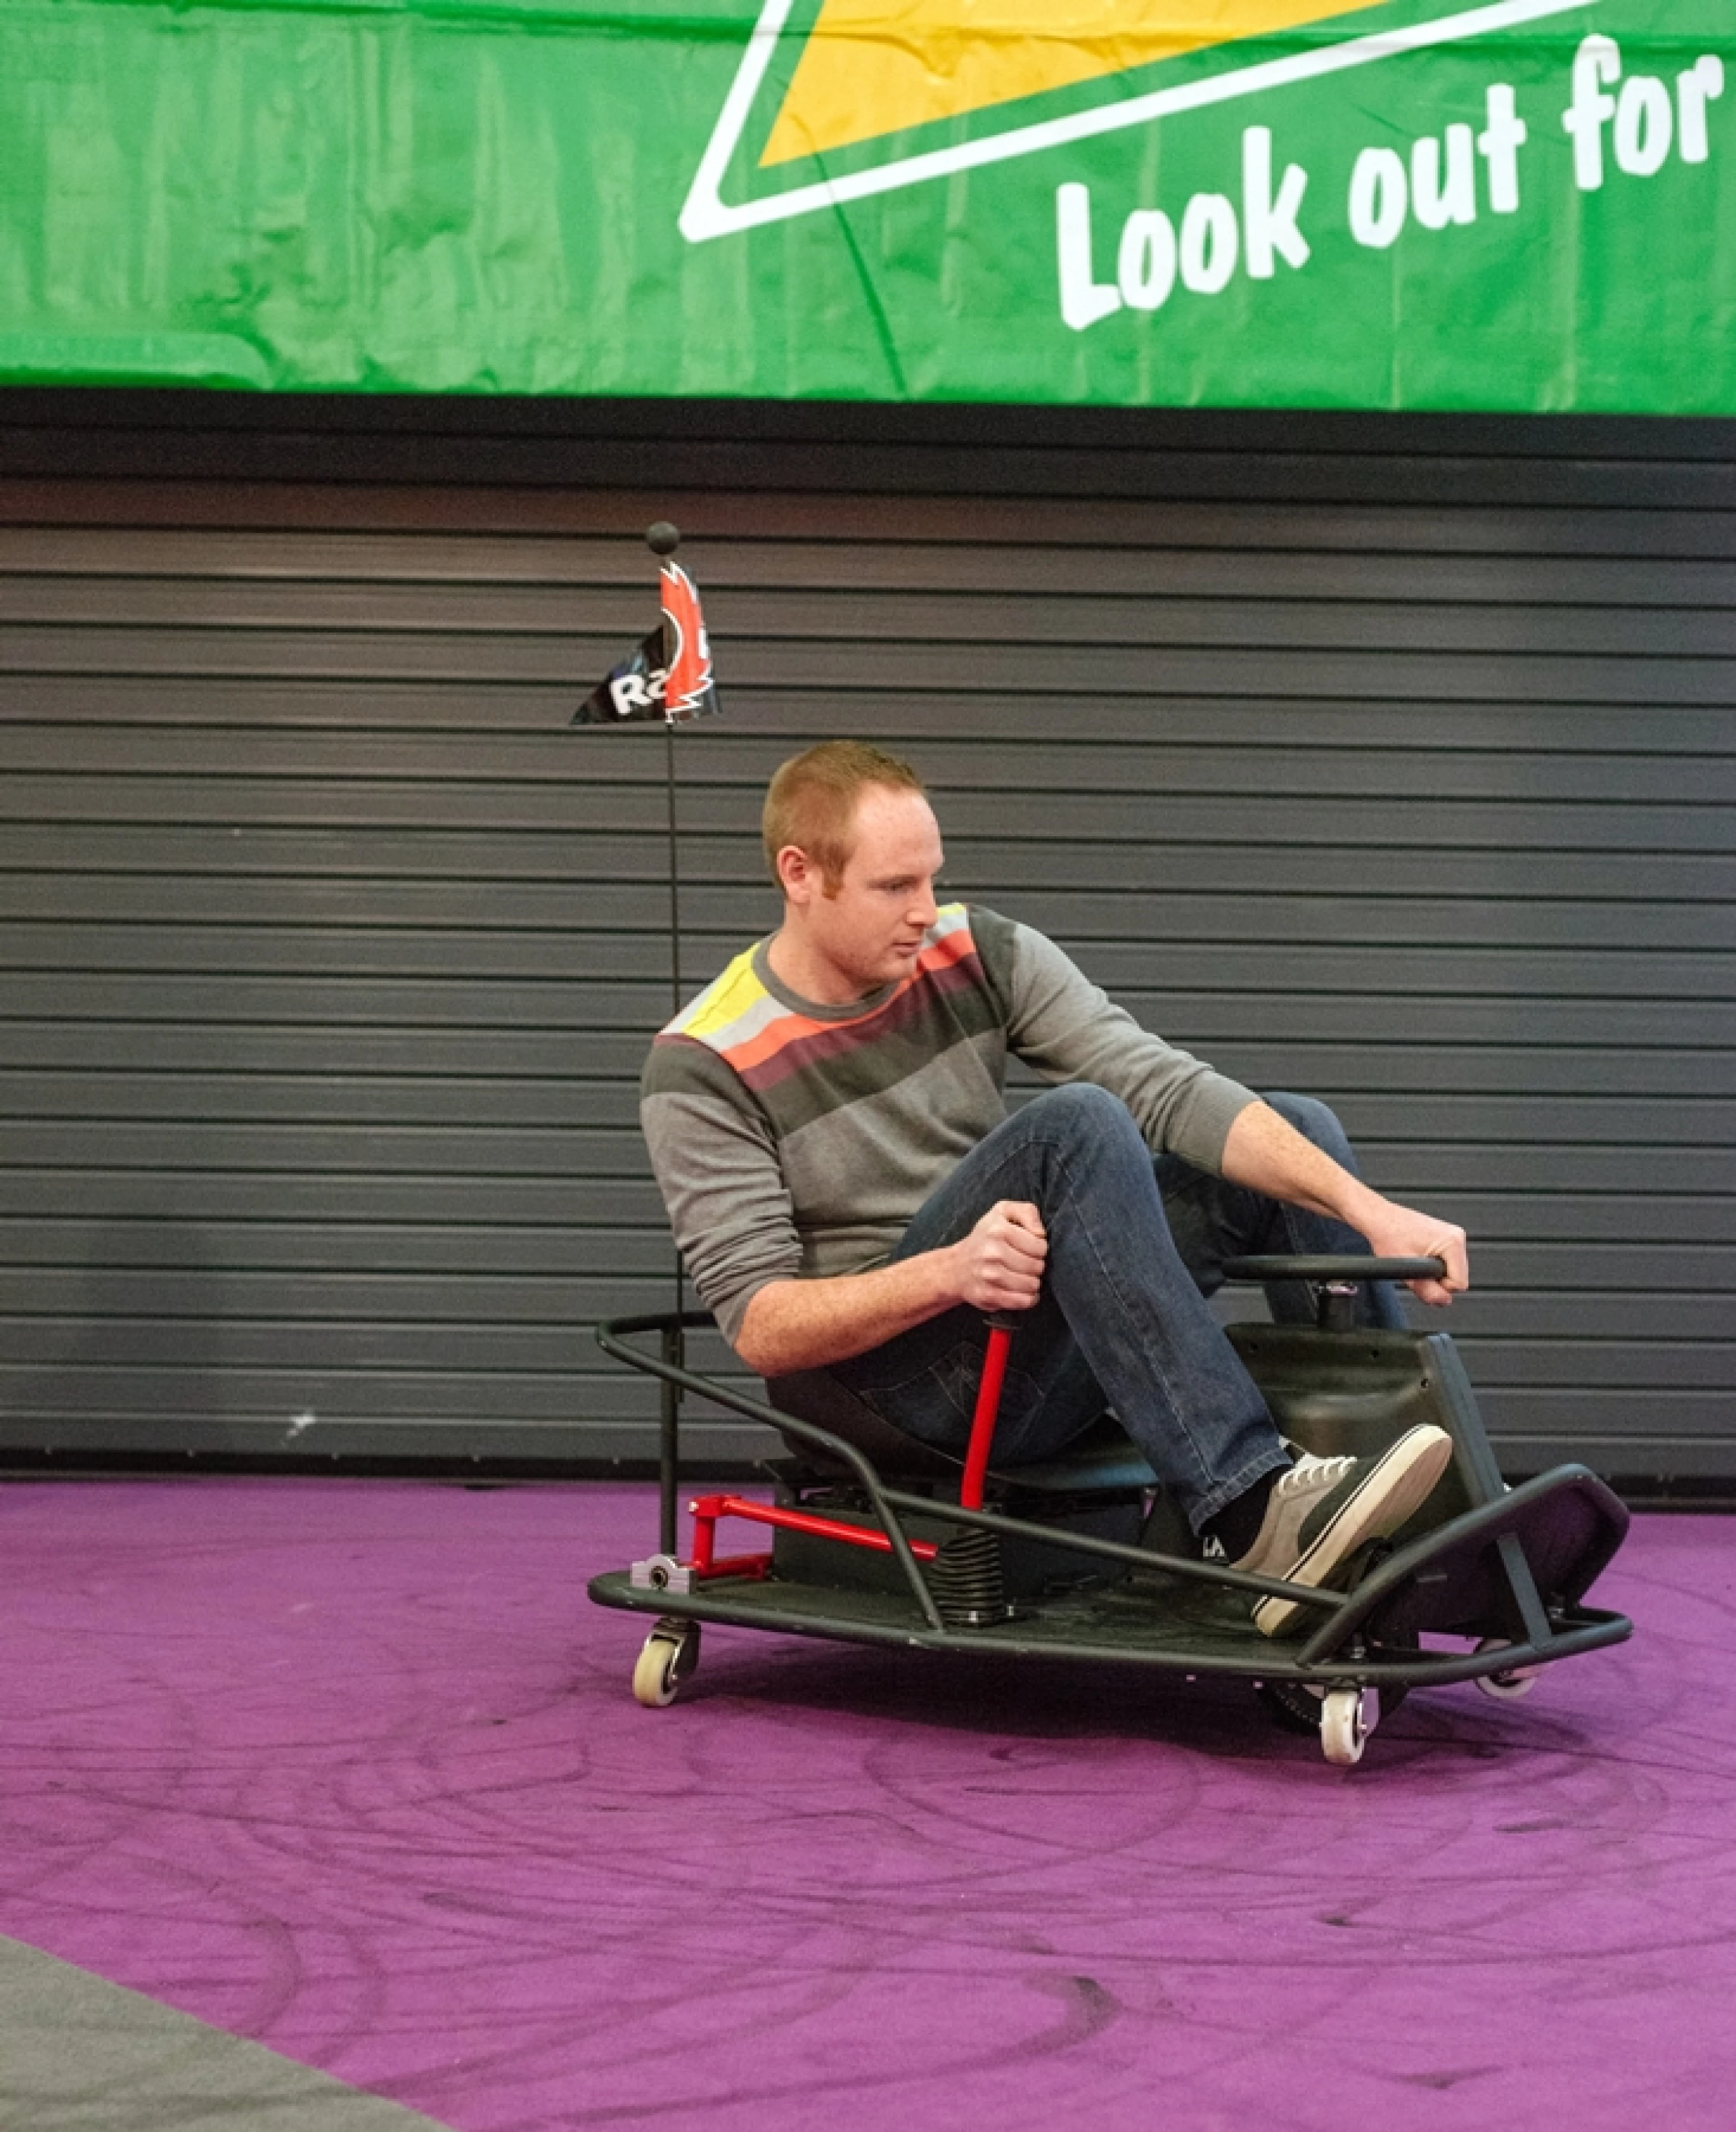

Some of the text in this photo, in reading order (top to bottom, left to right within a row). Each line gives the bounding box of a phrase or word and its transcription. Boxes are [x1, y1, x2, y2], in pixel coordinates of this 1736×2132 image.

[1056, 34, 1724, 330] Look out for
